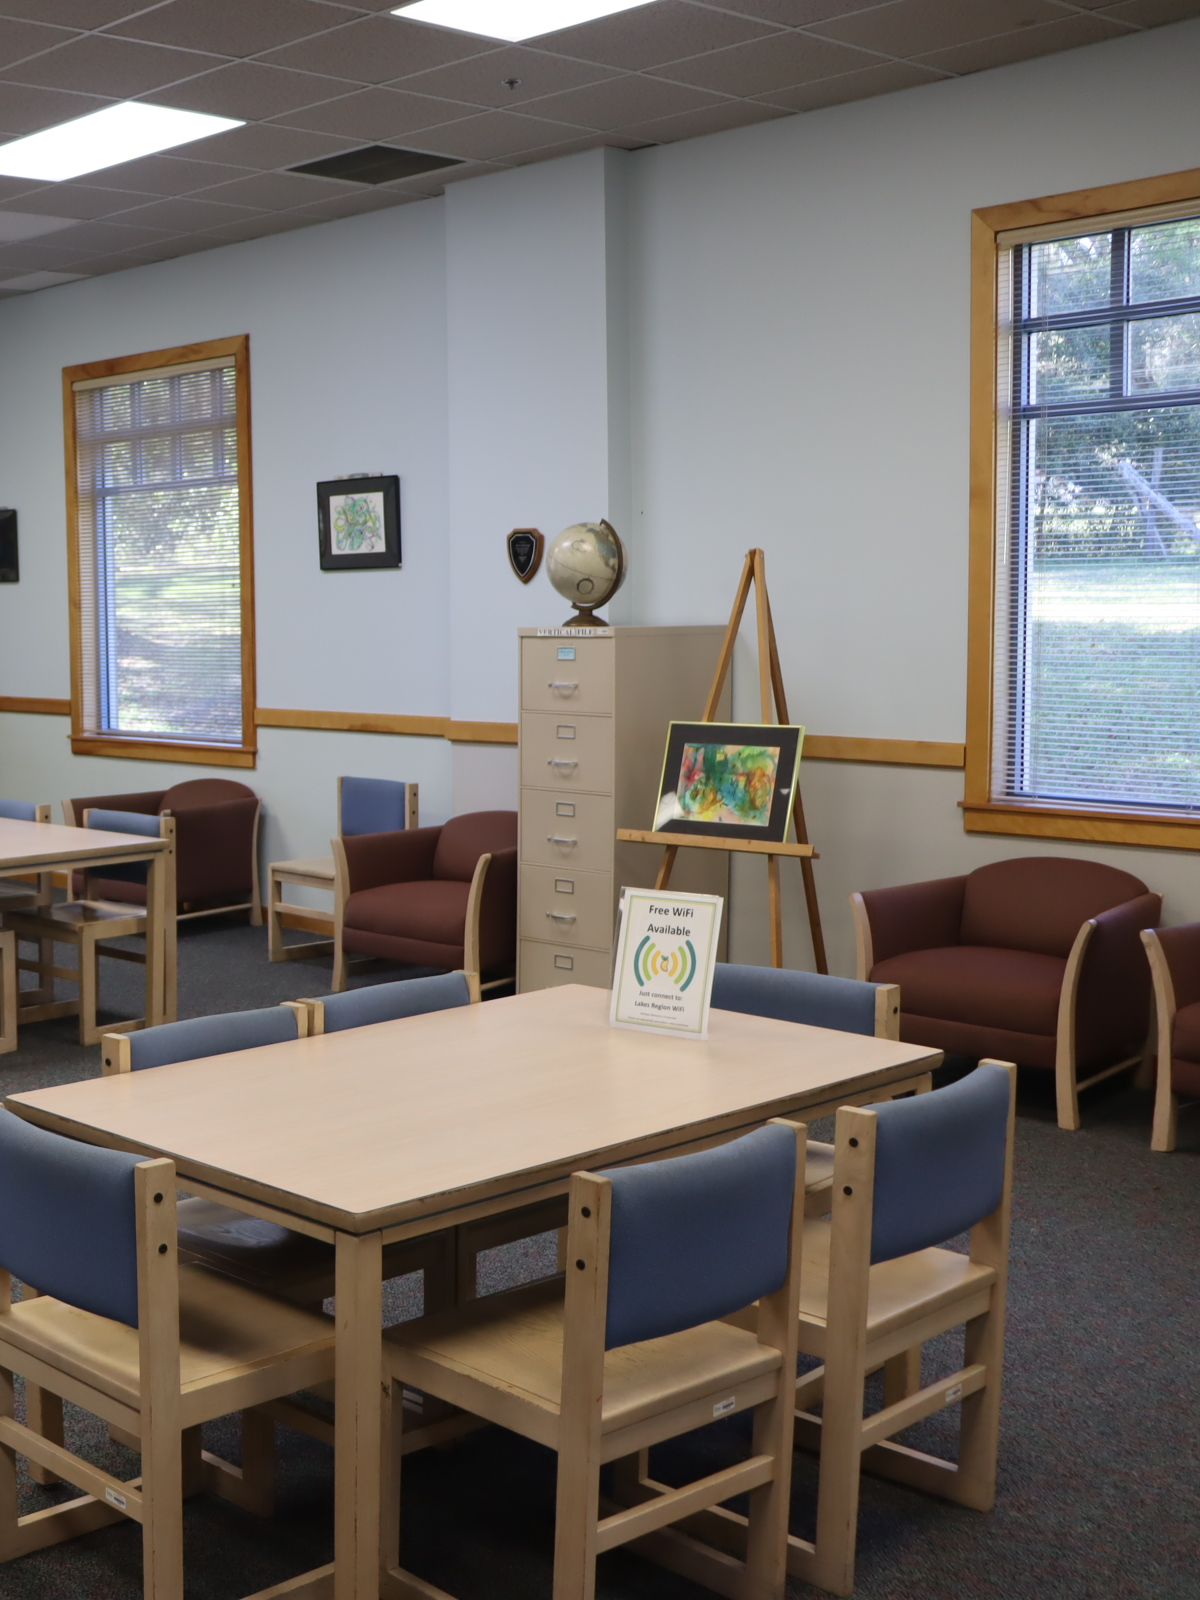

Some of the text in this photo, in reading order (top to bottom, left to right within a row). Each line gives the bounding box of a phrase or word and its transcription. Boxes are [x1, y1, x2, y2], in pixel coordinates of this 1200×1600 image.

[539, 628, 573, 636] VERTICAL
[577, 628, 593, 636] FILE
[649, 904, 694, 918] Free WiFi
[647, 923, 691, 937] Available
[651, 992, 674, 1001] connect
[634, 1000, 650, 1008] Lakes
[651, 1002, 671, 1011] Region
